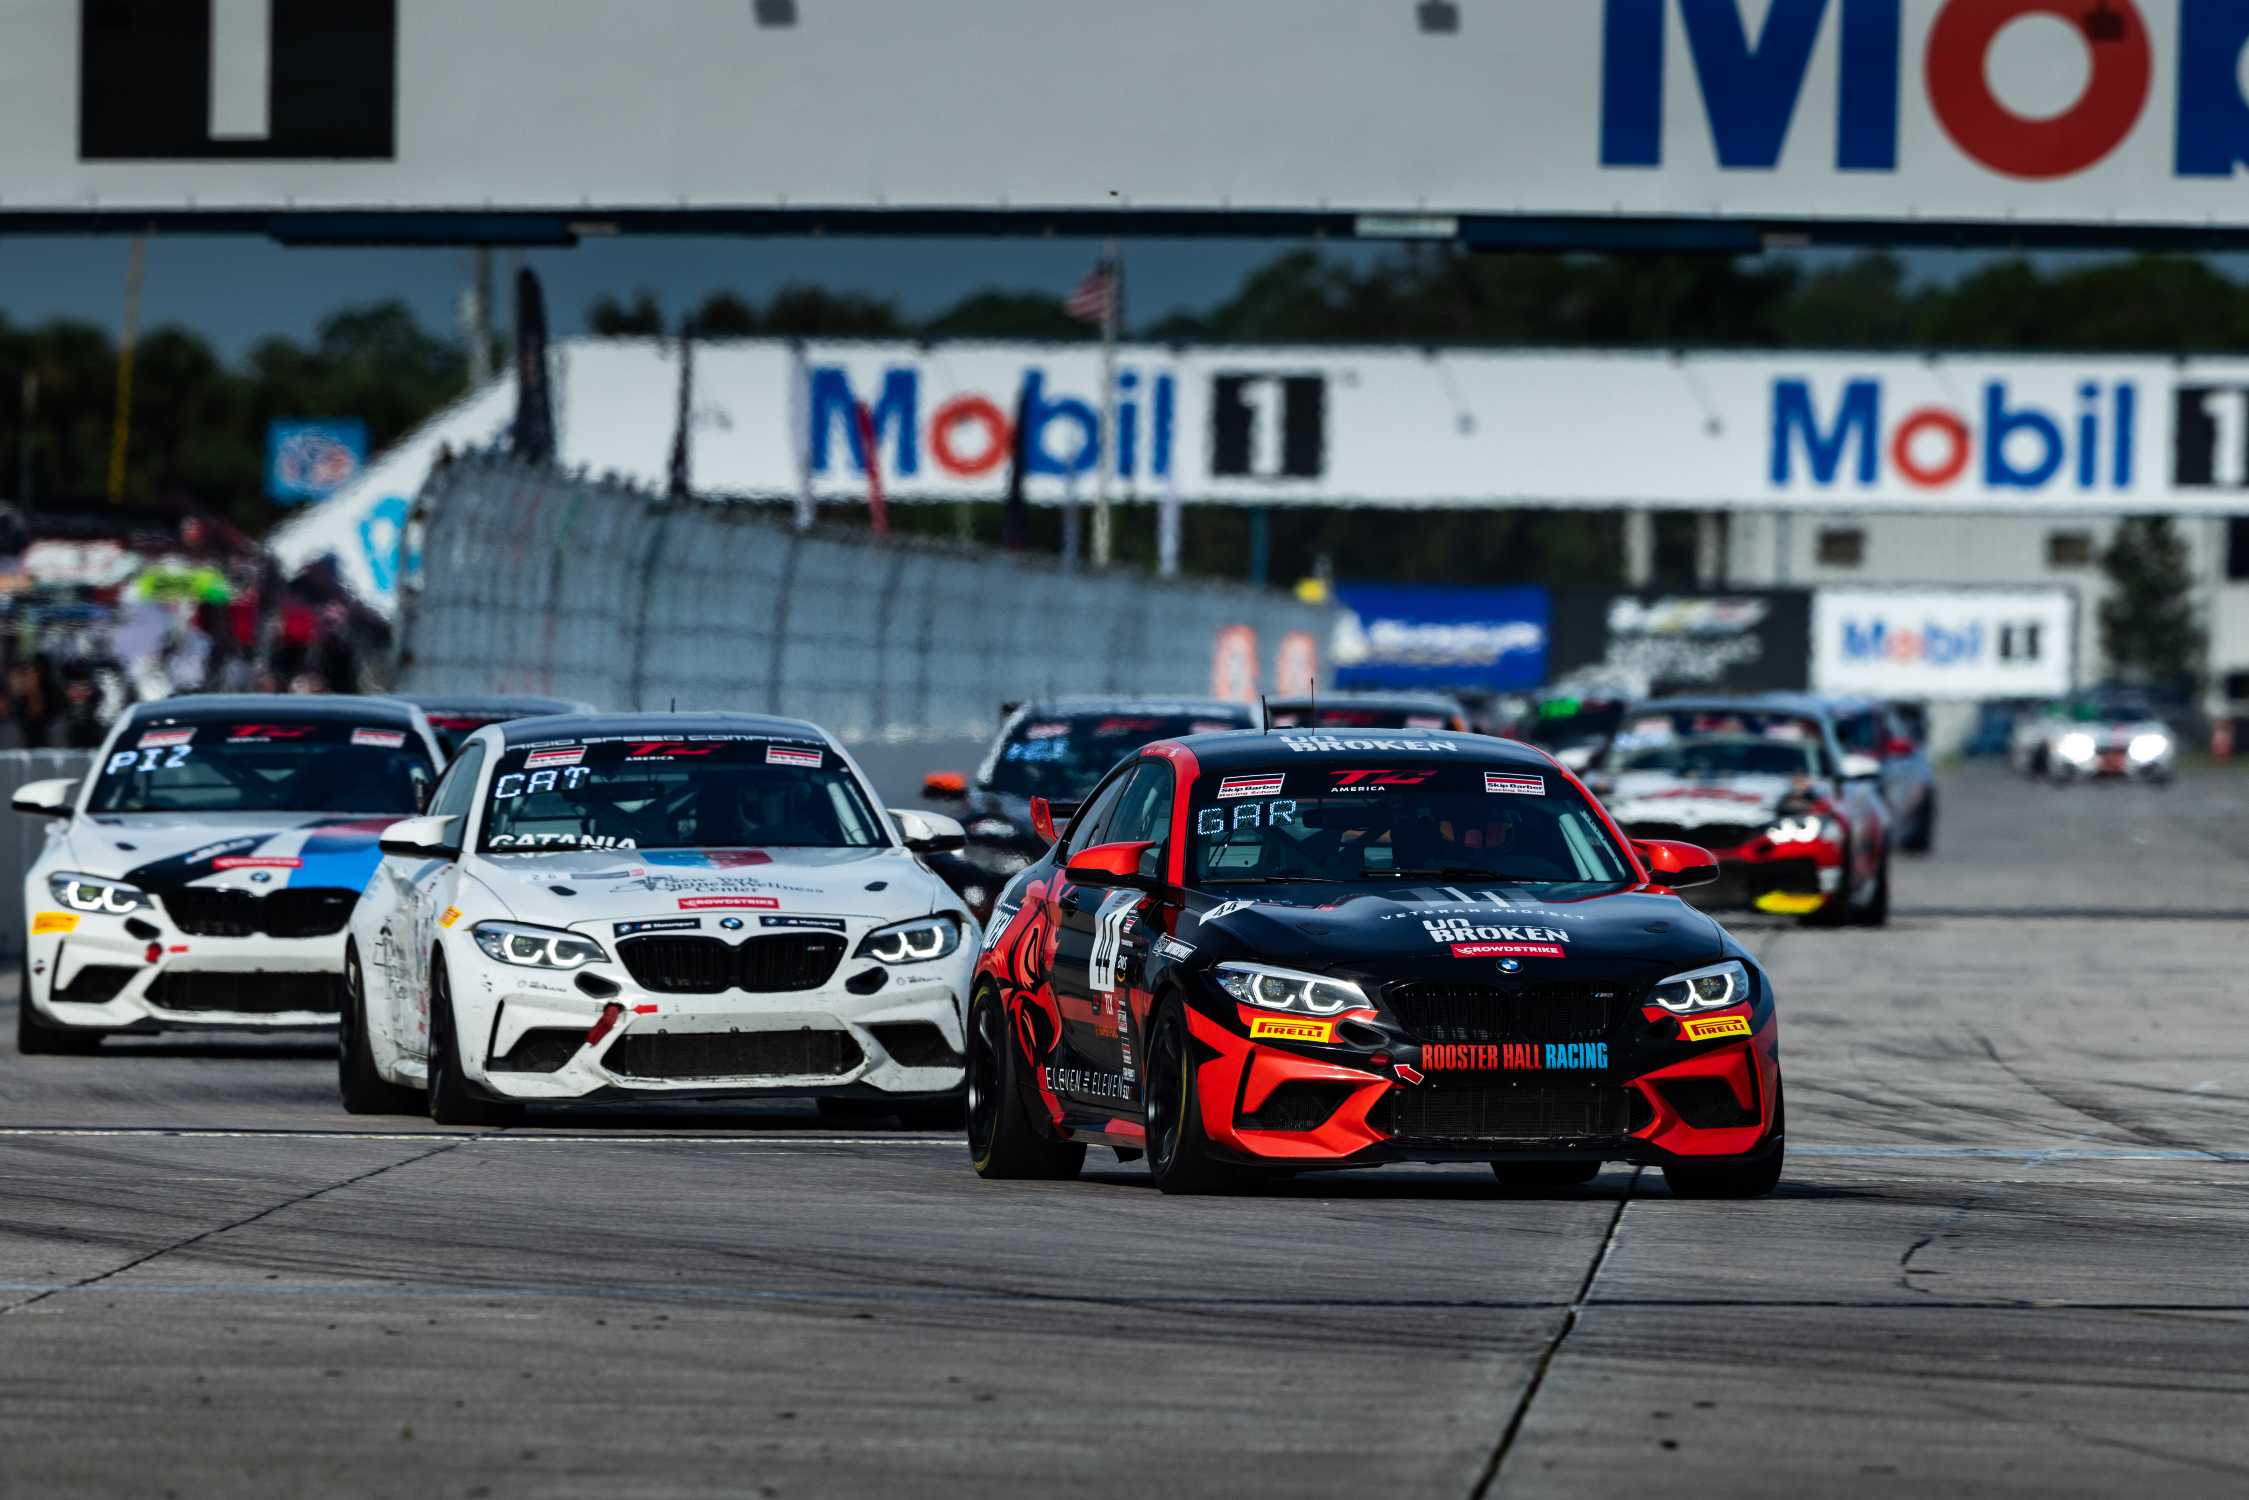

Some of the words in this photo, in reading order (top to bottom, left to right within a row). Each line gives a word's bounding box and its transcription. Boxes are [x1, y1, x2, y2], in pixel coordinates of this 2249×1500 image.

[807, 367, 1176, 478] Mobil
[1238, 380, 1288, 479] 1
[1770, 378, 2137, 489] Mobil
[1840, 619, 1983, 666] Mobil
[1287, 740, 1459, 751] BROKEN
[495, 766, 591, 798] CAT
[1244, 784, 1281, 792] Barber
[1198, 799, 1297, 835] GAR
[488, 832, 637, 850] CATANIA
[686, 898, 775, 908] CROWDSTRIKE
[1212, 901, 1238, 917] 44
[1379, 907, 1481, 920] VETERAN
[1492, 907, 1585, 920] PROJECT
[1428, 926, 1571, 943] BROKEN
[1464, 945, 1559, 955] CROWDSTRIKE
[1257, 1021, 1324, 1038] PIRELLI
[1689, 1019, 1746, 1036] PIRELLI
[1421, 1043, 1499, 1071] ROOSTER
[1502, 1043, 1543, 1070] HALL
[1545, 1042, 1608, 1069] RACING
[1045, 1066, 1082, 1093] ELEVEN
[1091, 1071, 1124, 1098] ELEVEN
